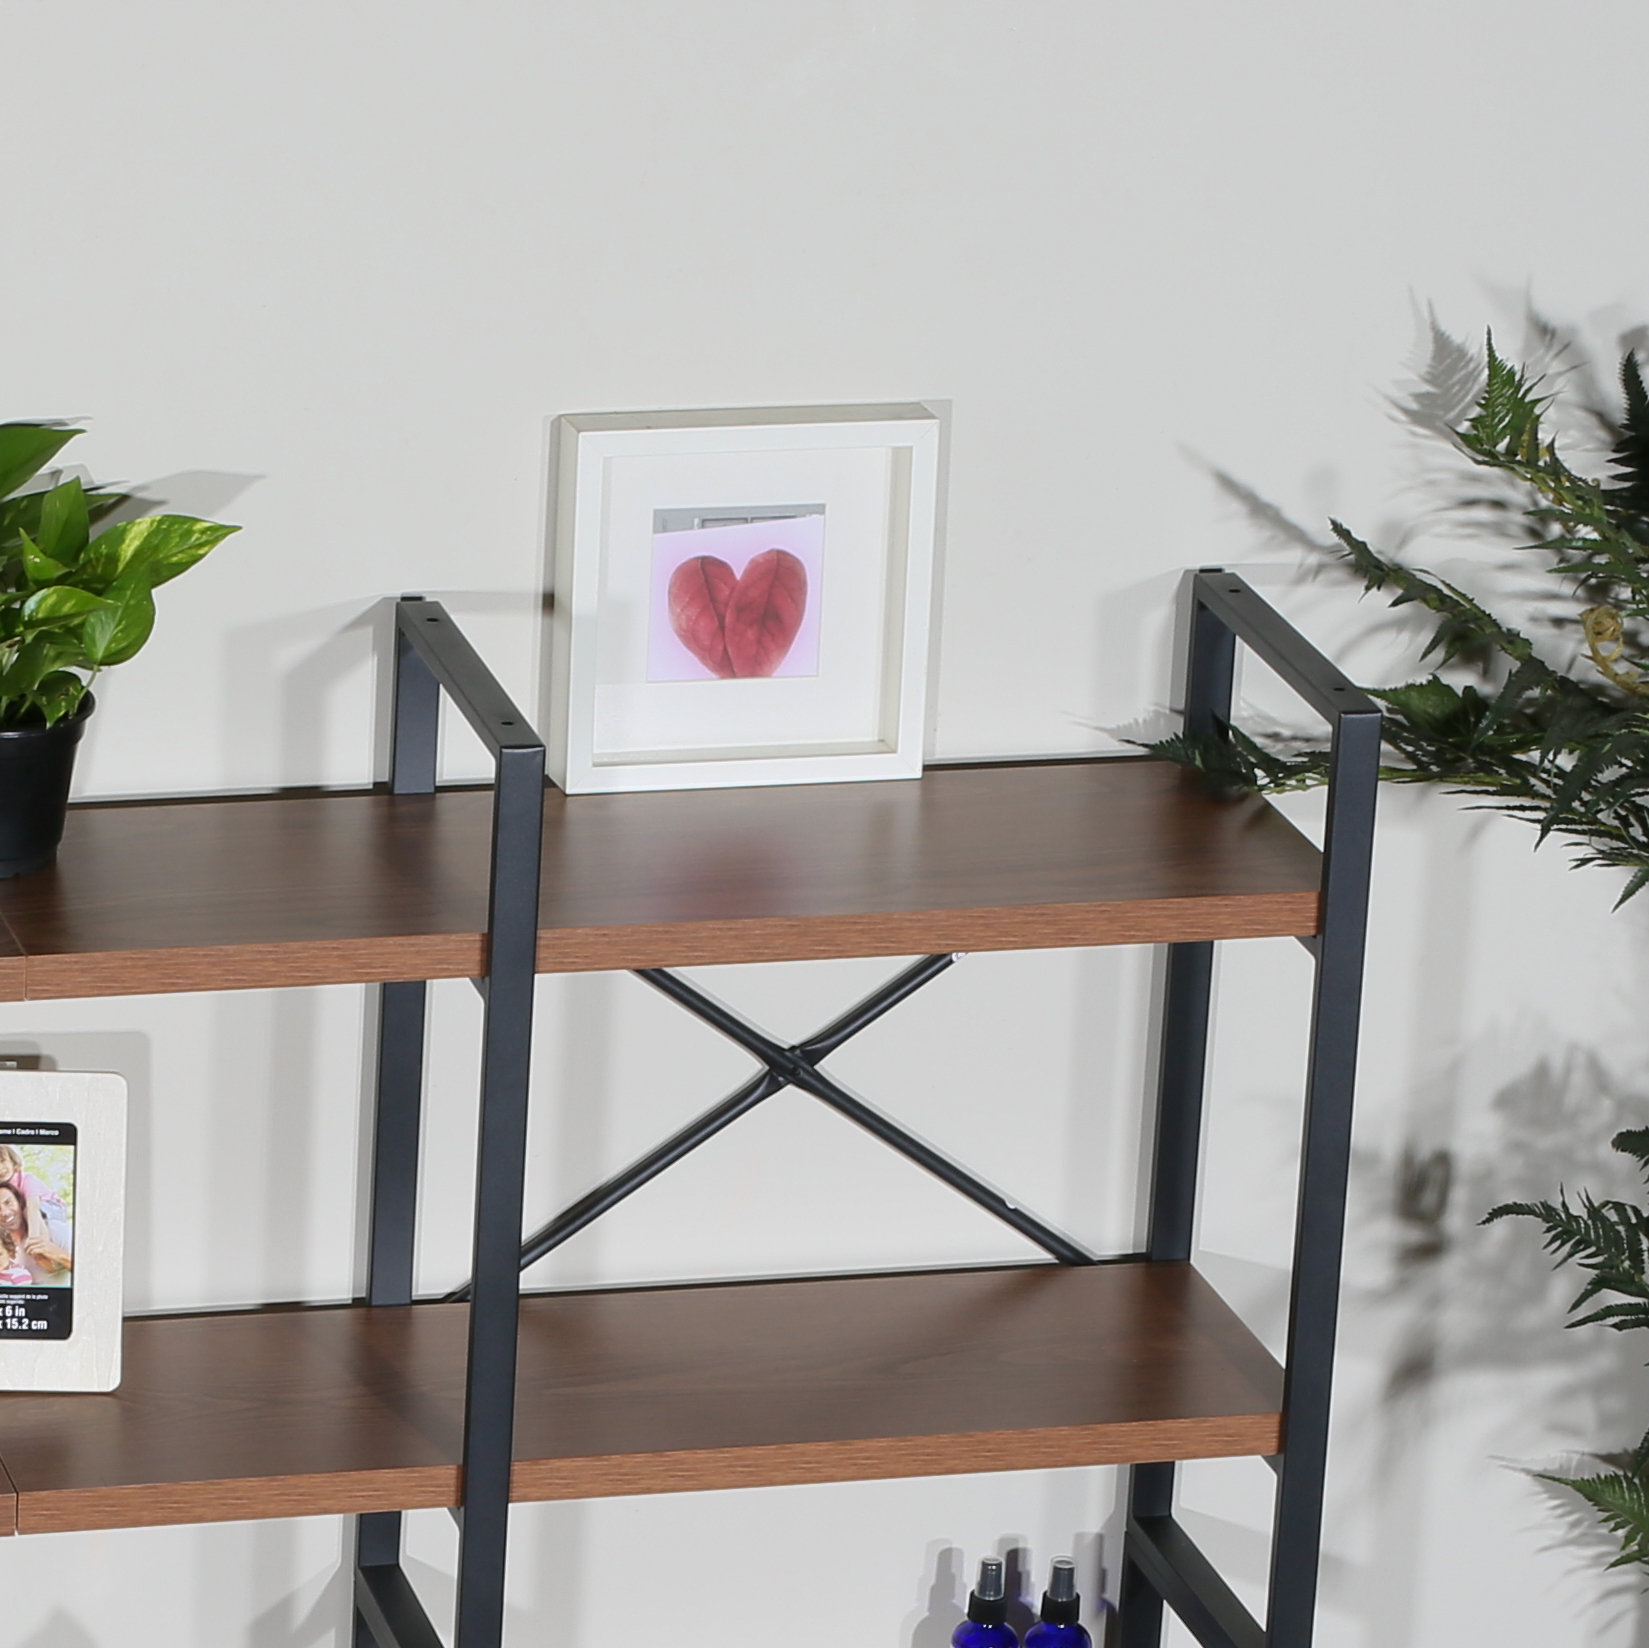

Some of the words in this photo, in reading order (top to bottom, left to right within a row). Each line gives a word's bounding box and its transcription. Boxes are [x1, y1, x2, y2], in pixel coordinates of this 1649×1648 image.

[5, 1305, 13, 1316] 6
[15, 1305, 26, 1317] in
[6, 1317, 30, 1329] 15.2
[31, 1320, 48, 1330] cm
